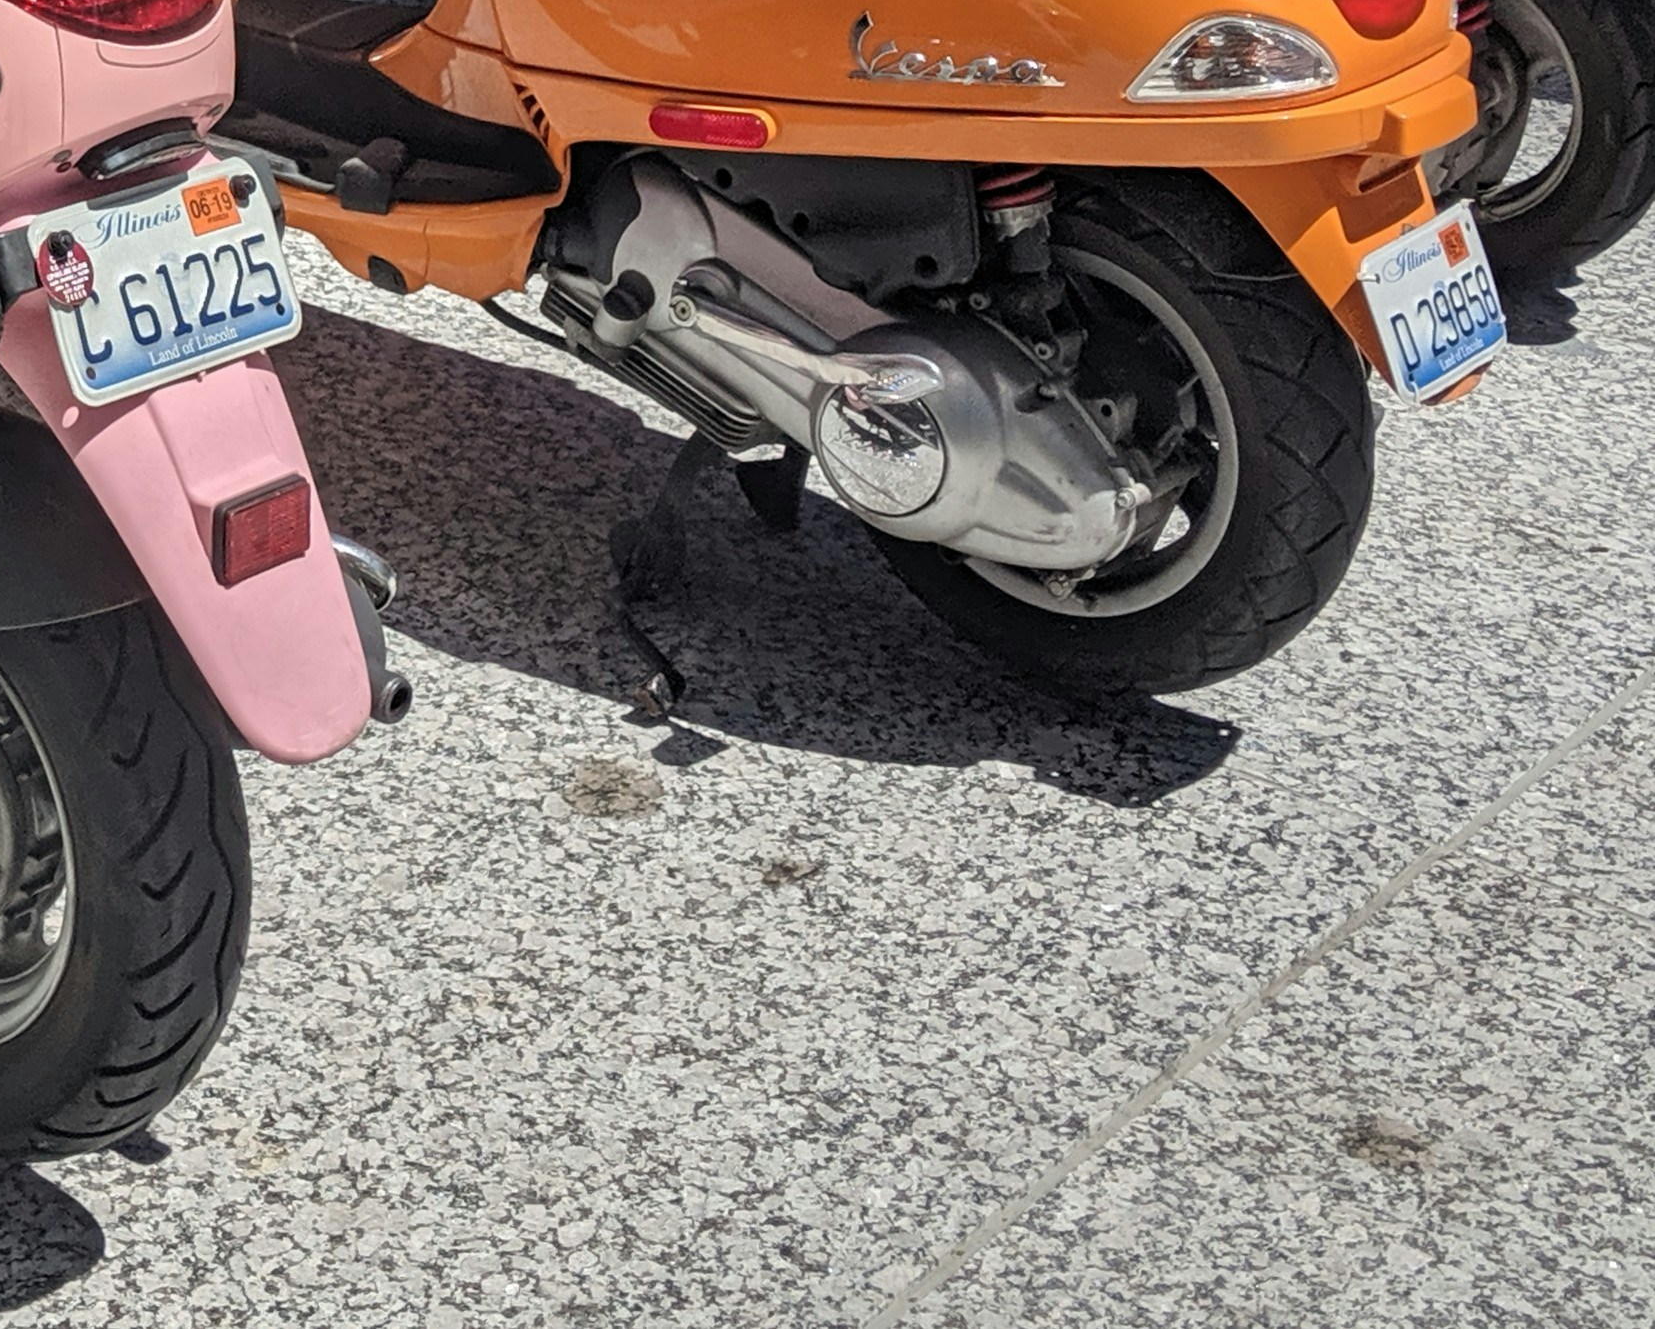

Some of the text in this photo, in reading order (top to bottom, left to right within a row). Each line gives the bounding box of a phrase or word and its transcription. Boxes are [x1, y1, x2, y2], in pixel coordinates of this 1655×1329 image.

[849, 10, 1066, 86] Vespa
[80, 204, 182, 249] Illinois
[189, 190, 233, 220] 06-19
[1383, 242, 1442, 284] Illinois
[119, 232, 282, 346] 61225
[148, 325, 239, 367] Land of Lincoln
[1390, 312, 1421, 373] D
